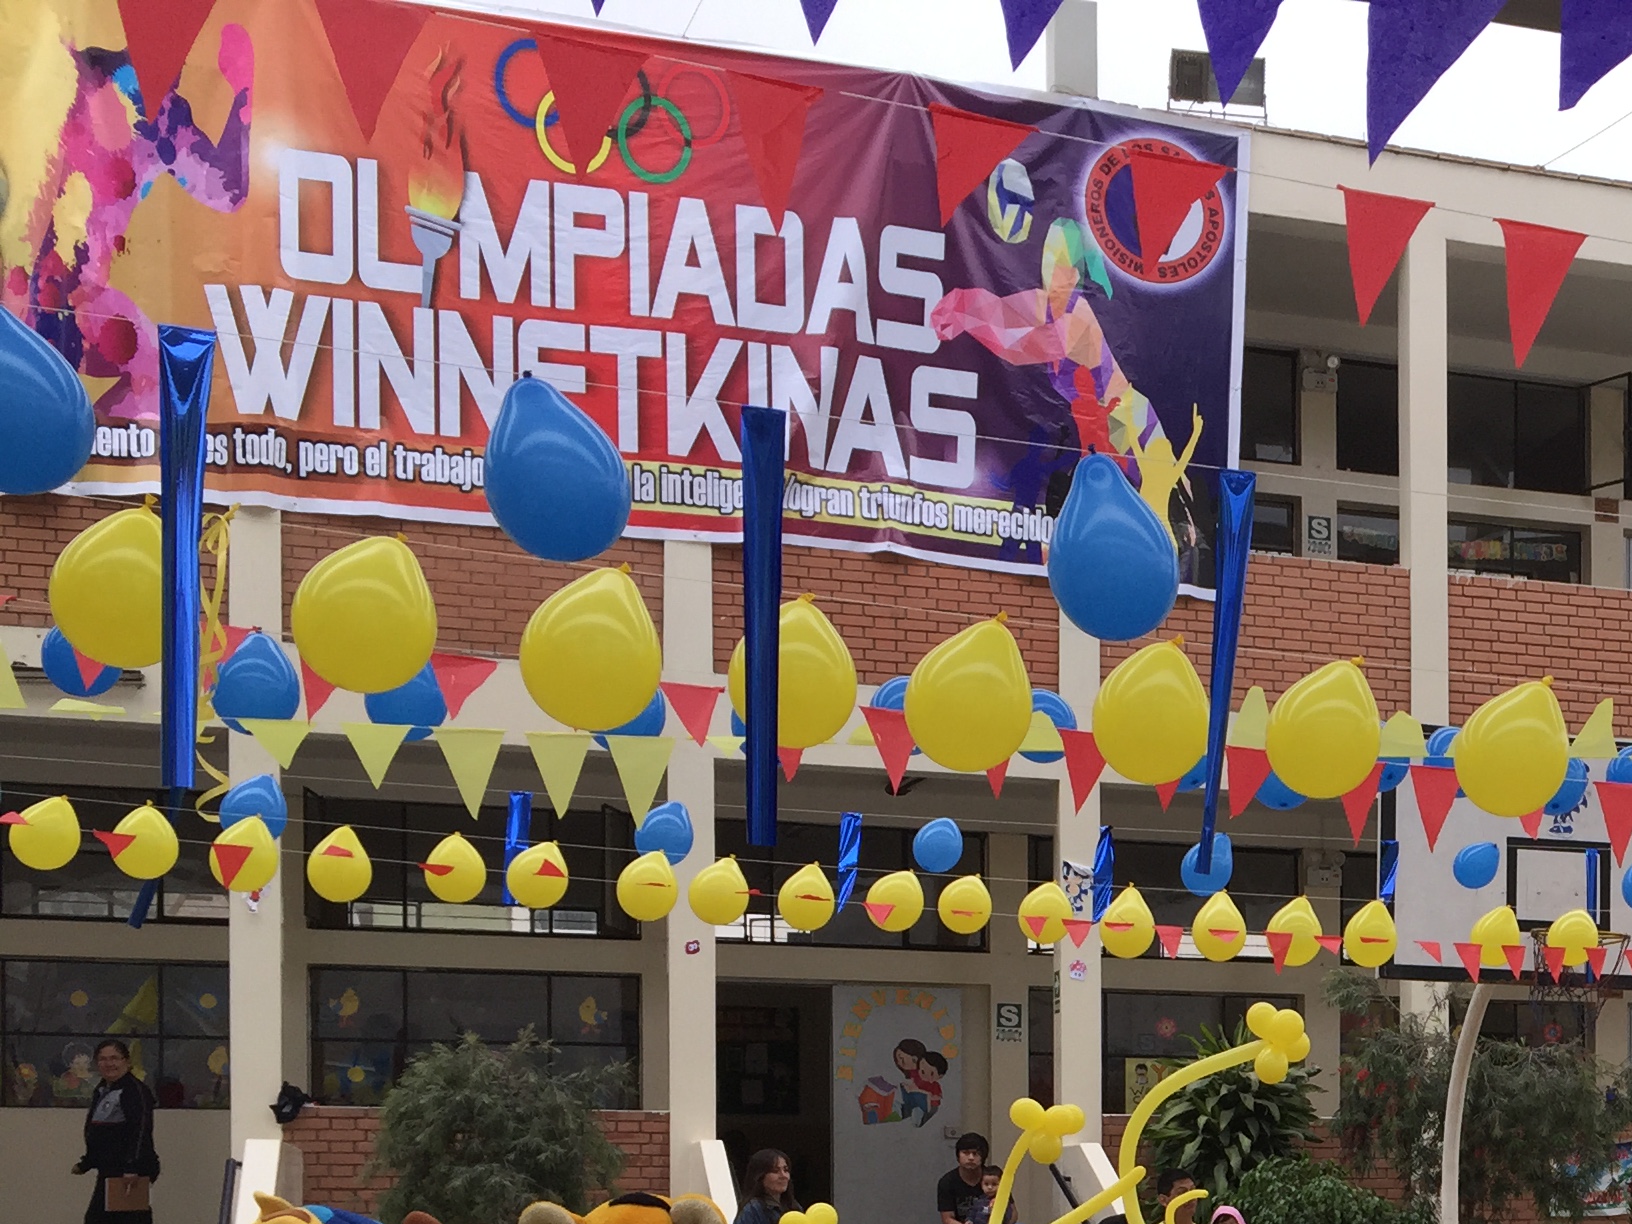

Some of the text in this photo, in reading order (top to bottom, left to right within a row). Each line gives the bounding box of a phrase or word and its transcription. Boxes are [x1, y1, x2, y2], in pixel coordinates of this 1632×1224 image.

[1099, 153, 1121, 175] DE
[1157, 206, 1220, 278] APOSTOLES
[233, 427, 293, 475] todo,
[298, 439, 360, 479] pero
[364, 440, 388, 479] el
[393, 444, 485, 493] trabajo
[631, 467, 656, 504] la
[859, 485, 949, 530] triunfos
[952, 503, 1057, 544] merecido
[1311, 518, 1329, 539] S
[999, 1005, 1019, 1027] S
